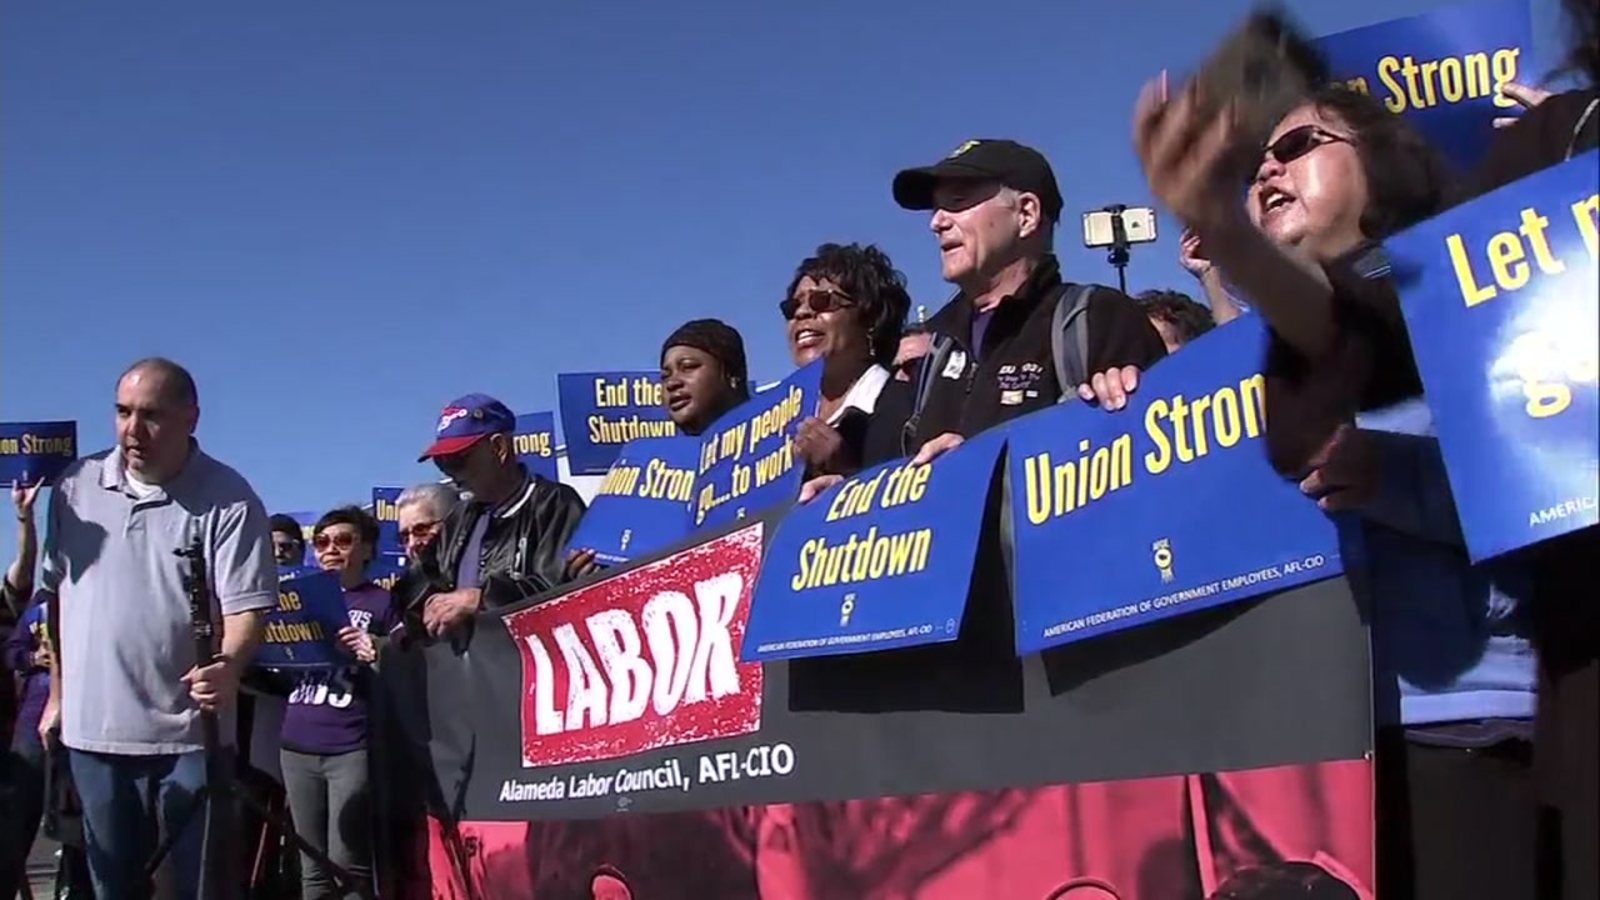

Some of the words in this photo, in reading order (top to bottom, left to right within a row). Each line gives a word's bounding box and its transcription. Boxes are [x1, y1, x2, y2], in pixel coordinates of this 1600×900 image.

[1377, 47, 1520, 114] Strong
[1446, 207, 1566, 308] Let
[595, 377, 628, 407] End
[633, 376, 663, 406] the
[21, 433, 73, 457] Strong
[513, 432, 552, 457] rong
[588, 415, 676, 443] Shutdown
[699, 433, 720, 475] Let
[720, 422, 747, 460] my
[749, 384, 803, 453] people
[1024, 432, 1132, 525] Union
[1145, 373, 1266, 474] Stron
[638, 458, 696, 502] Stron
[755, 434, 794, 488] work
[376, 499, 400, 520] Uni
[825, 467, 887, 522] End
[881, 463, 932, 508] the
[791, 527, 932, 591] Shutdown
[1043, 619, 1086, 638] AMERICAN
[1086, 604, 1138, 626] FEDERATION
[1139, 600, 1152, 612] OF
[1153, 581, 1221, 608] GOVERNMENT
[1222, 566, 1283, 591] EMPLOYEES,
[1284, 555, 1325, 574] AFL-CIO
[526, 572, 743, 736] LABOR
[500, 776, 565, 801] Alameda
[568, 772, 613, 799] Labor
[614, 758, 690, 792] Council,
[698, 743, 795, 783] AFL-CIO
